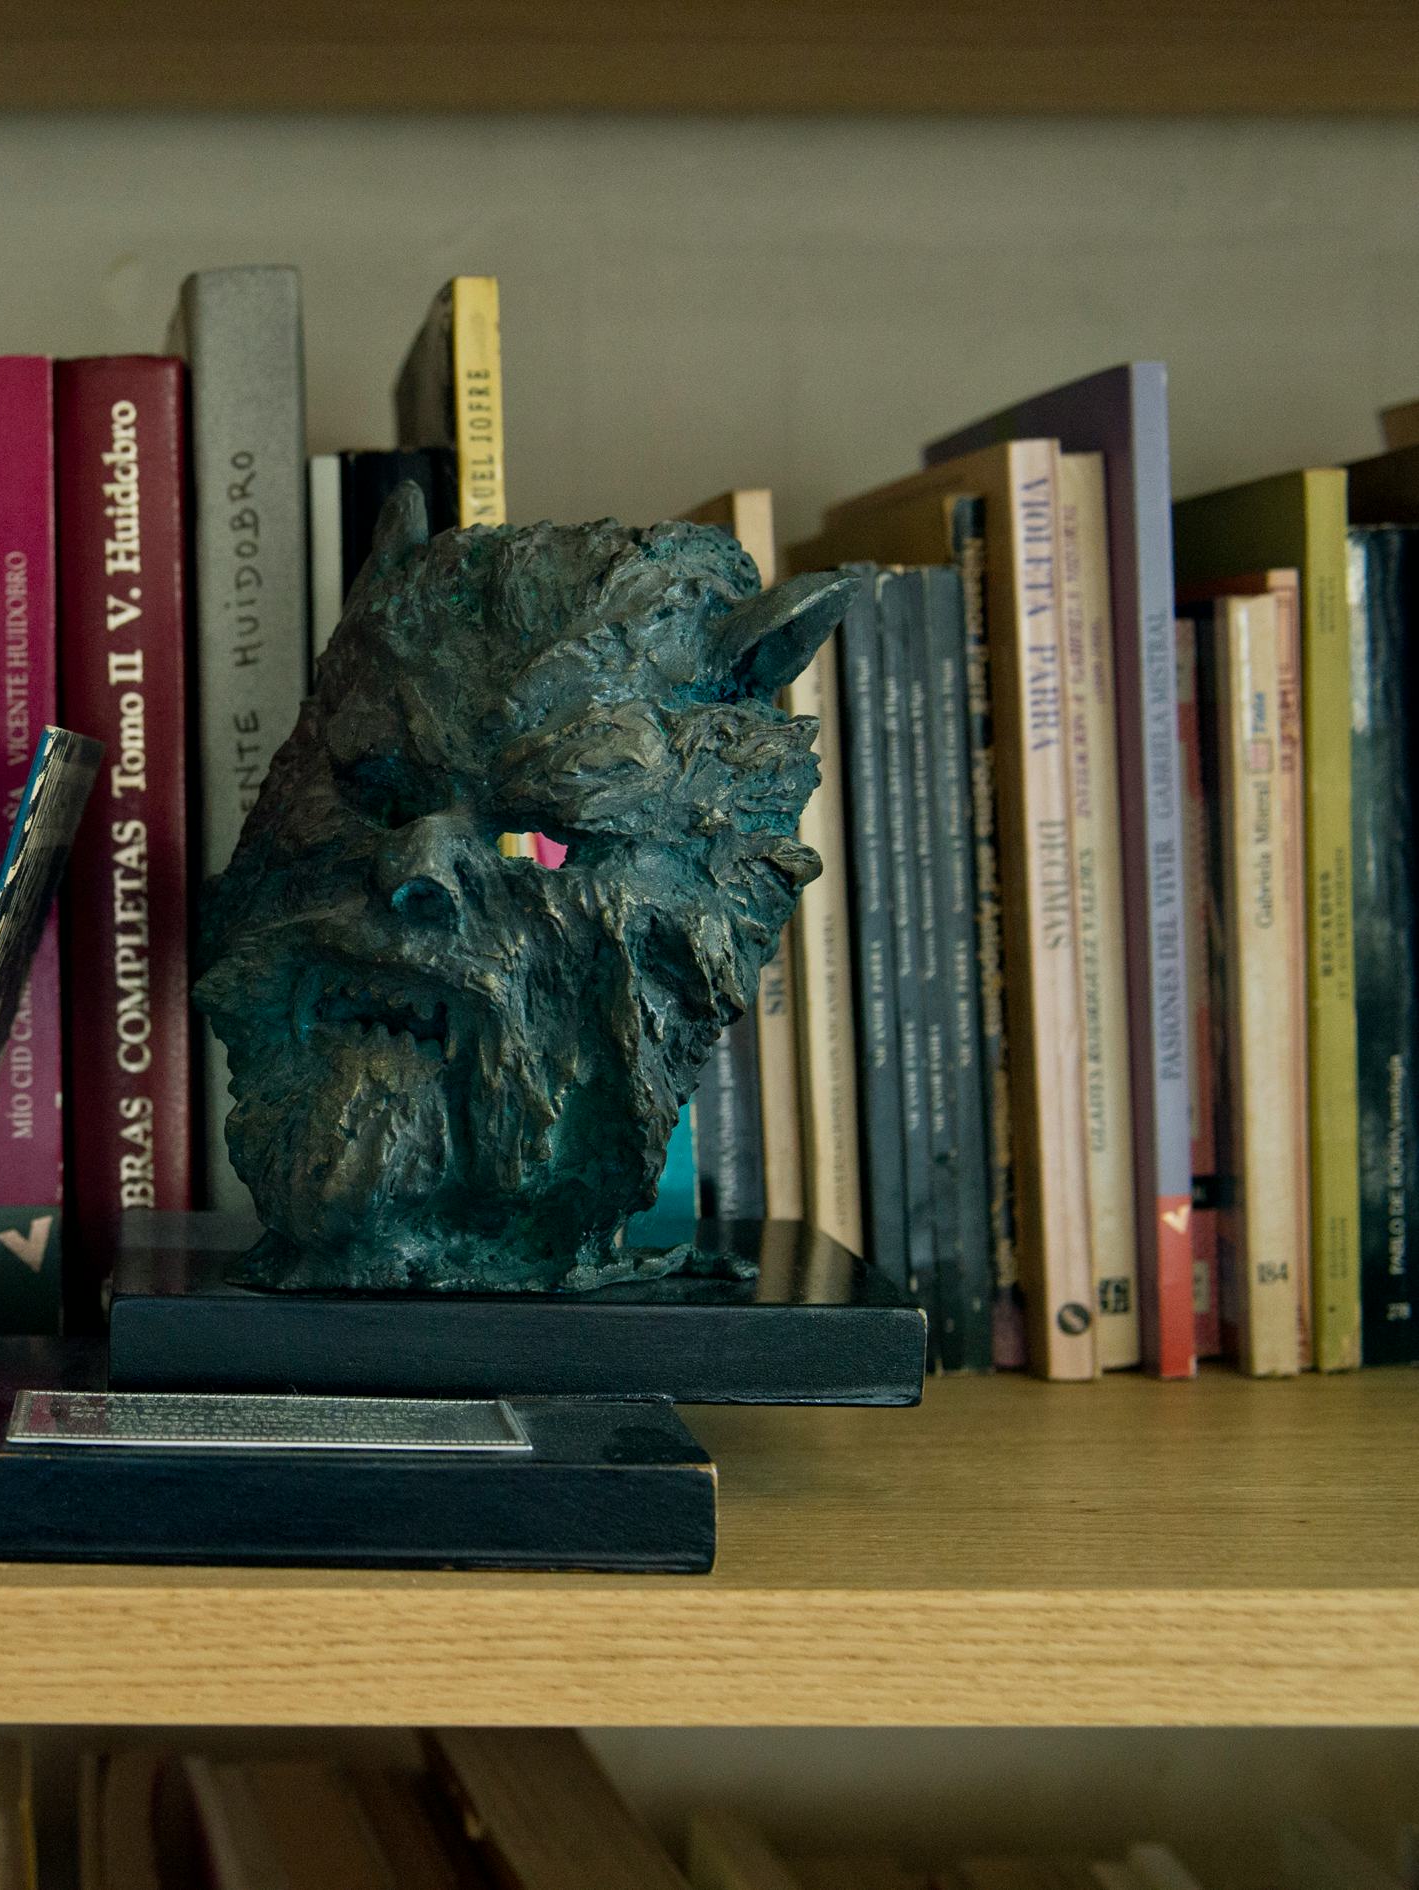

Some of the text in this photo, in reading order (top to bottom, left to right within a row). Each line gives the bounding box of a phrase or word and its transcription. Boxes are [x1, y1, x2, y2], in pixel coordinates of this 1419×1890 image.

[467, 368, 496, 516] NUEL JOFRE
[1018, 477, 1054, 617] VIOLETA
[5, 551, 27, 667] HUIDOBRO
[7, 672, 28, 765] VICENTE
[1027, 644, 1058, 751] PARRA
[103, 401, 155, 1207] BRAS COMPLETAS Tomo II V. Huidobro
[233, 710, 261, 812] ENTE
[1147, 609, 1182, 1080] PASIONES DEL VIVIR GABRIELA MISTRAL
[1254, 852, 1275, 929] Gabriela
[5, 1094, 33, 1139] MÍO
[11, 1049, 33, 1088] CID
